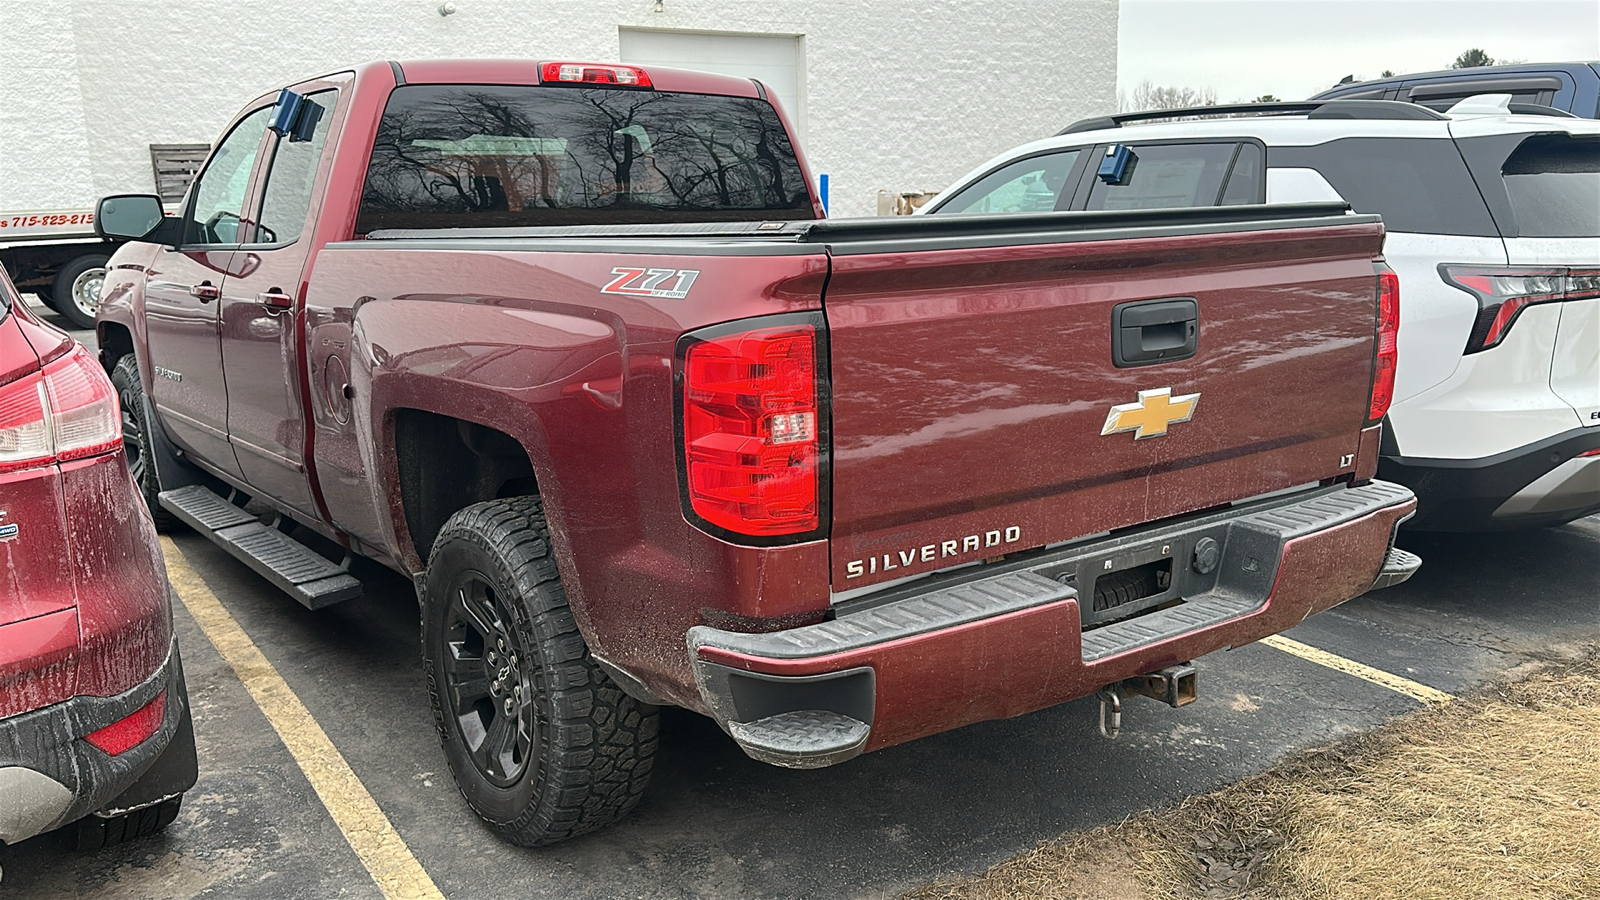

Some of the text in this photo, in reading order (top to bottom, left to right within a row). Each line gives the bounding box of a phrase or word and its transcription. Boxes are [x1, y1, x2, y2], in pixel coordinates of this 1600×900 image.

[0, 214, 94, 228] s 715-823-213
[600, 266, 700, 295] Z71
[1339, 453, 1355, 468] LT
[846, 525, 1021, 579] SILVERADO
